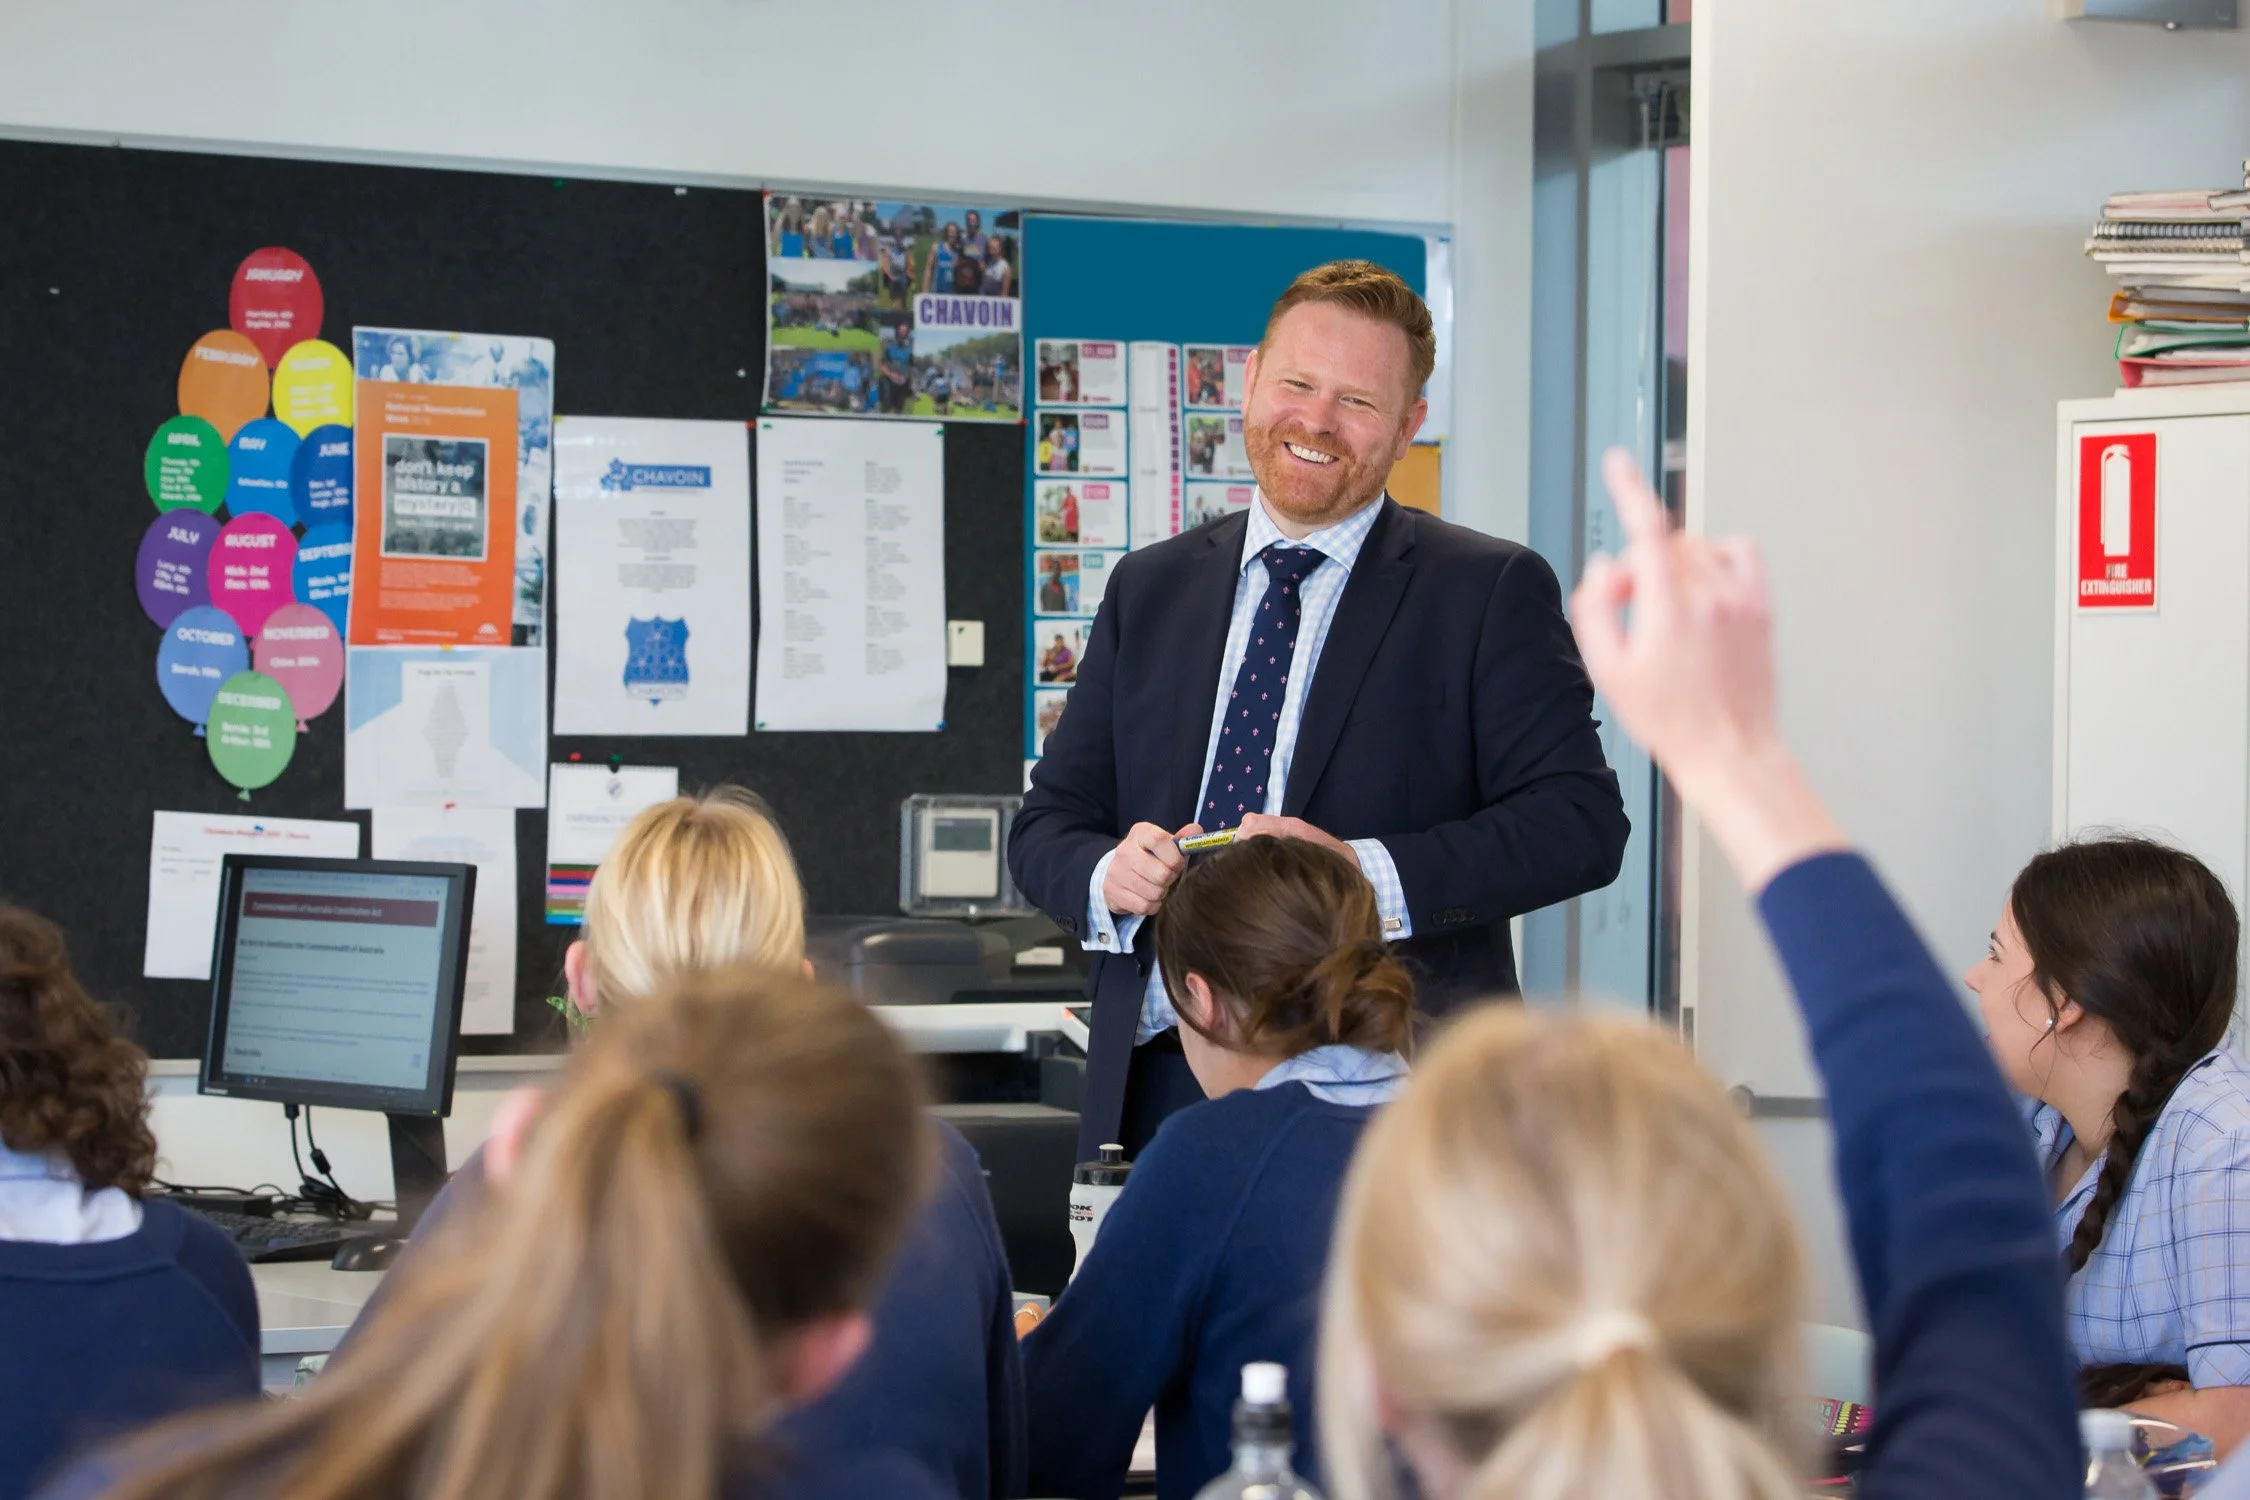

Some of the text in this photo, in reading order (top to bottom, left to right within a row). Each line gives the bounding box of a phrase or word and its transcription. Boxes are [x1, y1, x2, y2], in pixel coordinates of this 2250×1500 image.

[919, 298, 1013, 327] CHAVOIN
[319, 442, 349, 457] JUNE
[437, 460, 474, 480] keep
[632, 469, 705, 484] CHAVOIN
[451, 481, 462, 494] a
[167, 526, 200, 545] JULY
[224, 533, 277, 548] AUGUST
[2105, 563, 2128, 578] FIRE
[2080, 579, 2152, 595] EXTINGUISHER
[176, 627, 236, 646] OCTOBER
[263, 626, 330, 640] NOVEMBER
[1185, 840, 1212, 848] WHITEBOARD
